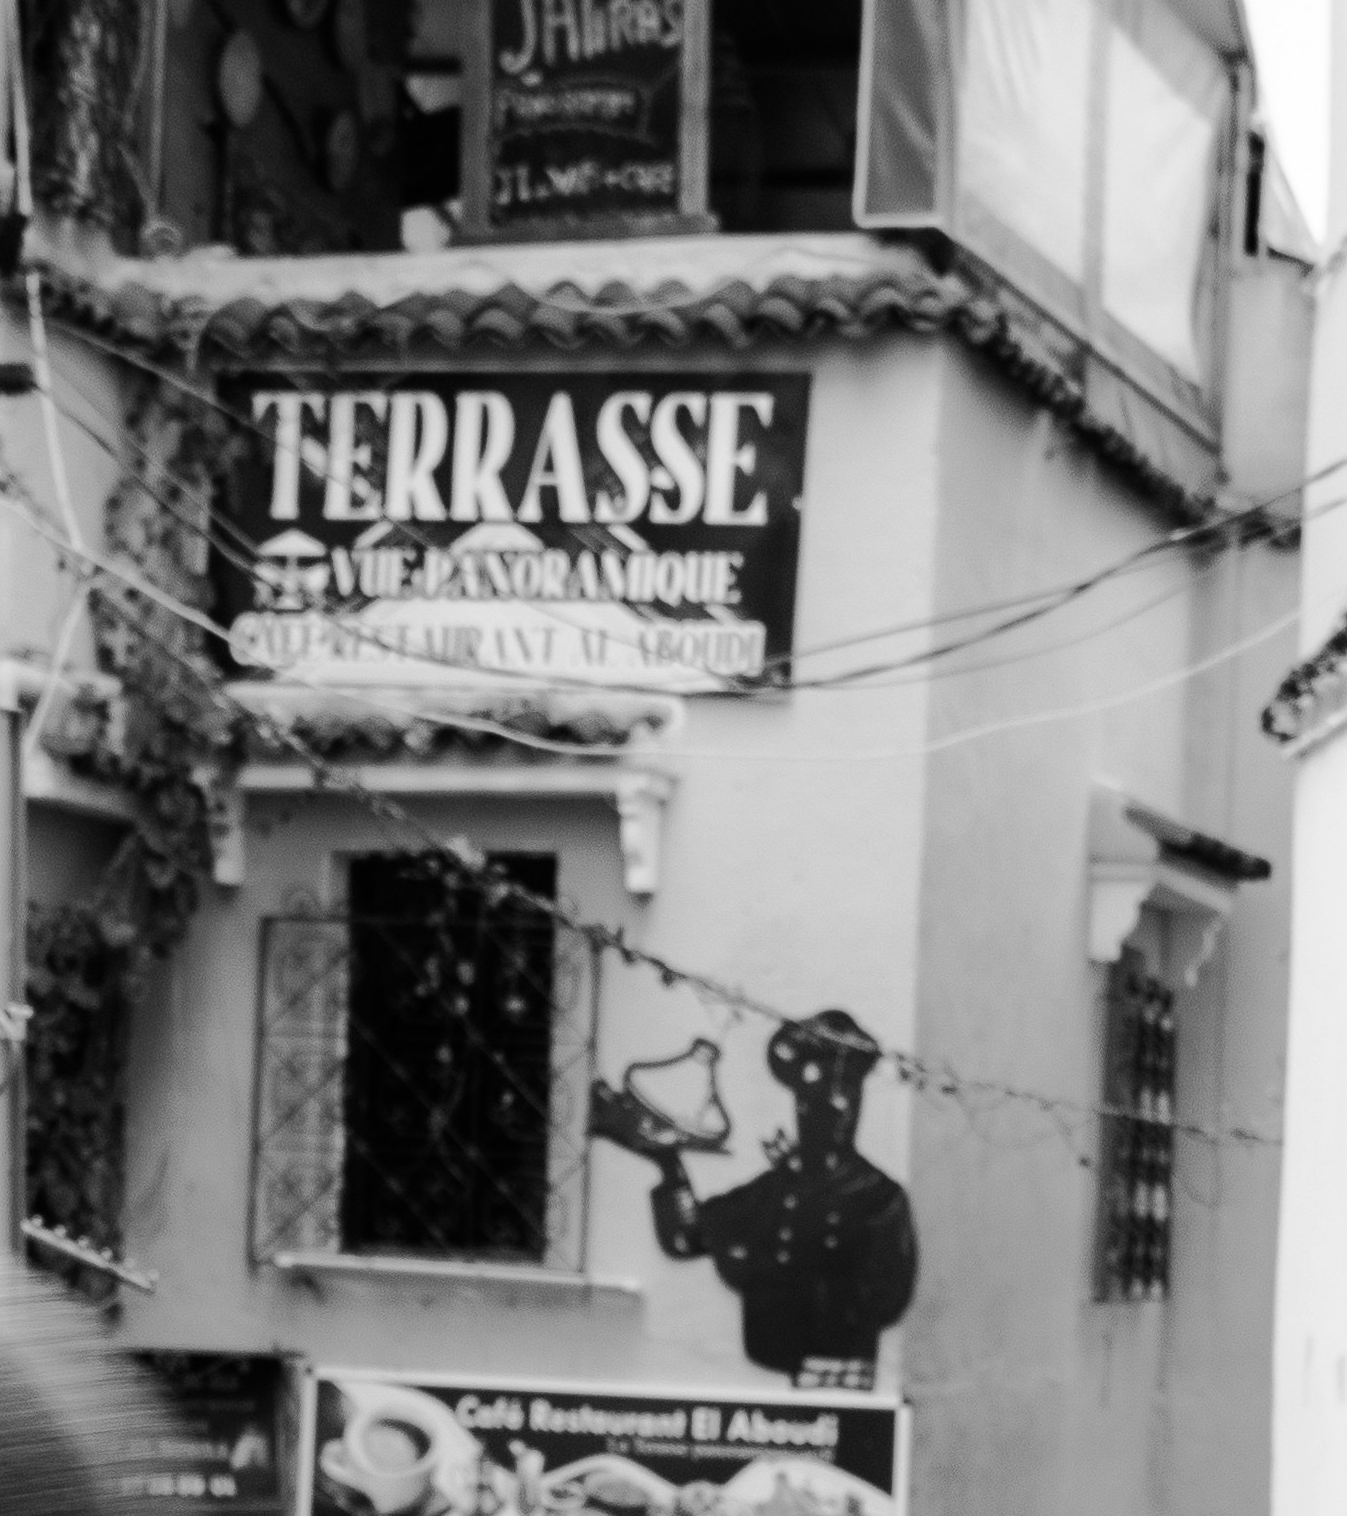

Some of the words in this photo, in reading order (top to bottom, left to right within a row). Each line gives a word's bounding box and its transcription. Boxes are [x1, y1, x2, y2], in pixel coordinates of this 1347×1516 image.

[252, 389, 774, 526] TERRASSE
[332, 546, 414, 598] VUE
[416, 548, 744, 606] PANORAMIQUE
[454, 1393, 525, 1431] Café
[528, 1398, 688, 1439] Restaurant
[691, 1405, 722, 1441] El
[726, 1408, 840, 1448] Aboudi
